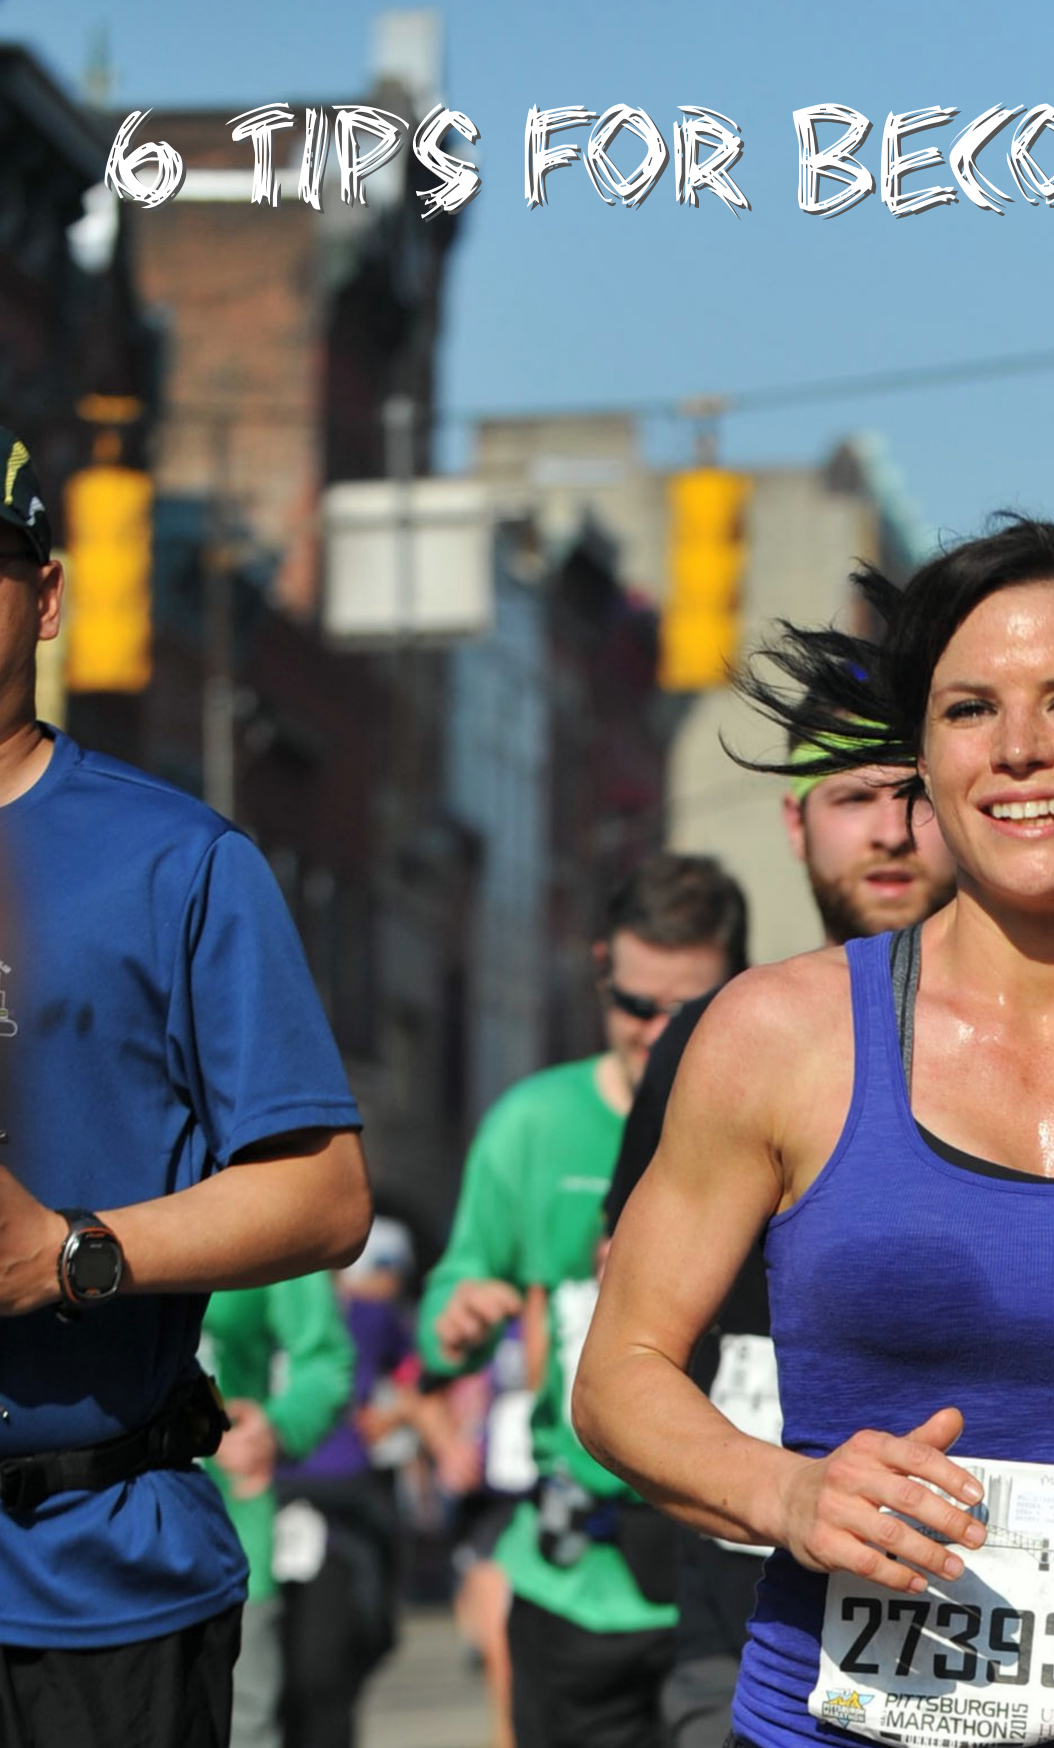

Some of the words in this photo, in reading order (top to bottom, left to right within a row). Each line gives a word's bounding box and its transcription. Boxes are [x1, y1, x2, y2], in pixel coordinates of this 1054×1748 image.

[884, 1692, 1010, 1719] PITTSBURGH
[886, 1710, 1009, 1740] MARATHON
[1010, 1702, 1029, 1740] 2015
